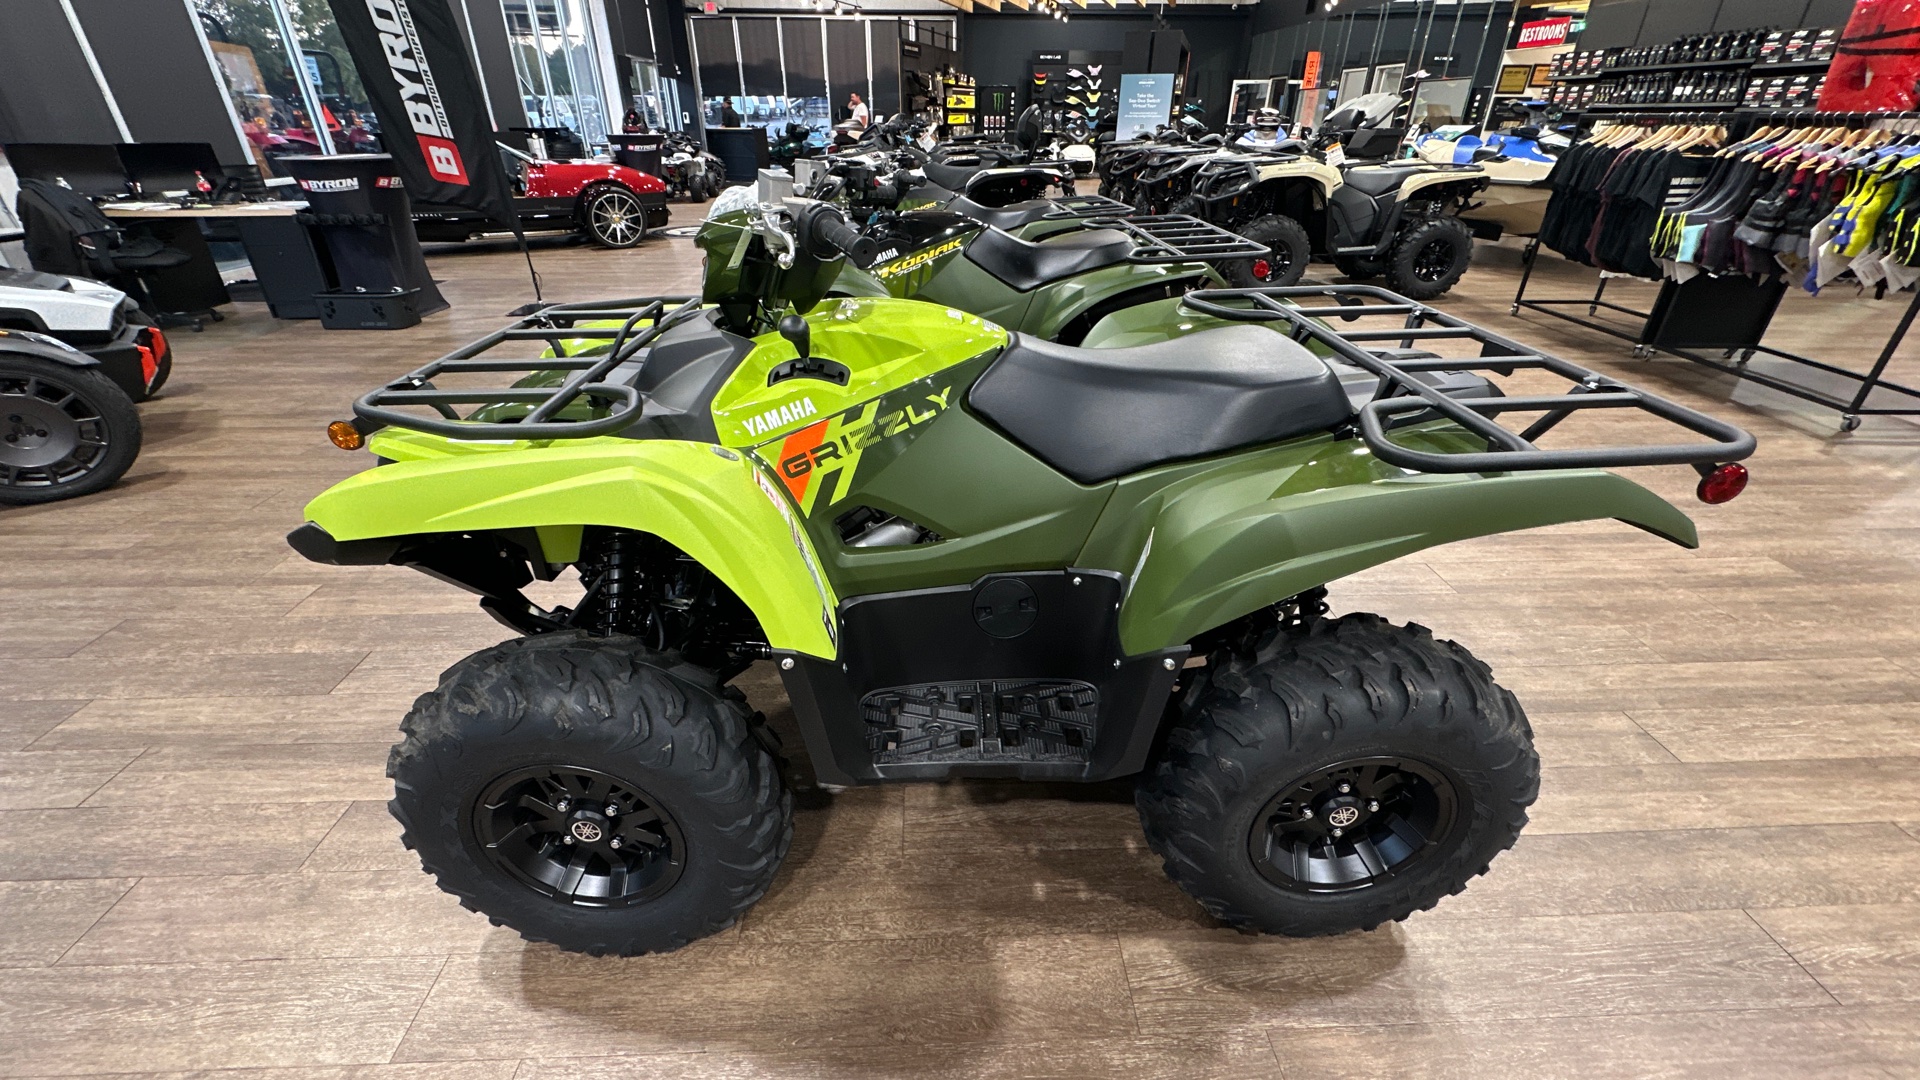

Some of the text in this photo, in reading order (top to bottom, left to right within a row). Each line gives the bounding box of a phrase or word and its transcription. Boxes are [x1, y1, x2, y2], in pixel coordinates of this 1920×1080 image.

[1519, 23, 1568, 43] RESTROOMS
[420, 69, 449, 128] OUTDOOR
[429, 145, 460, 176] B
[309, 177, 359, 190] BYRON
[877, 238, 963, 278] KODIAK
[742, 396, 818, 437] YAMAHA
[782, 386, 952, 479] GRIZZLY
